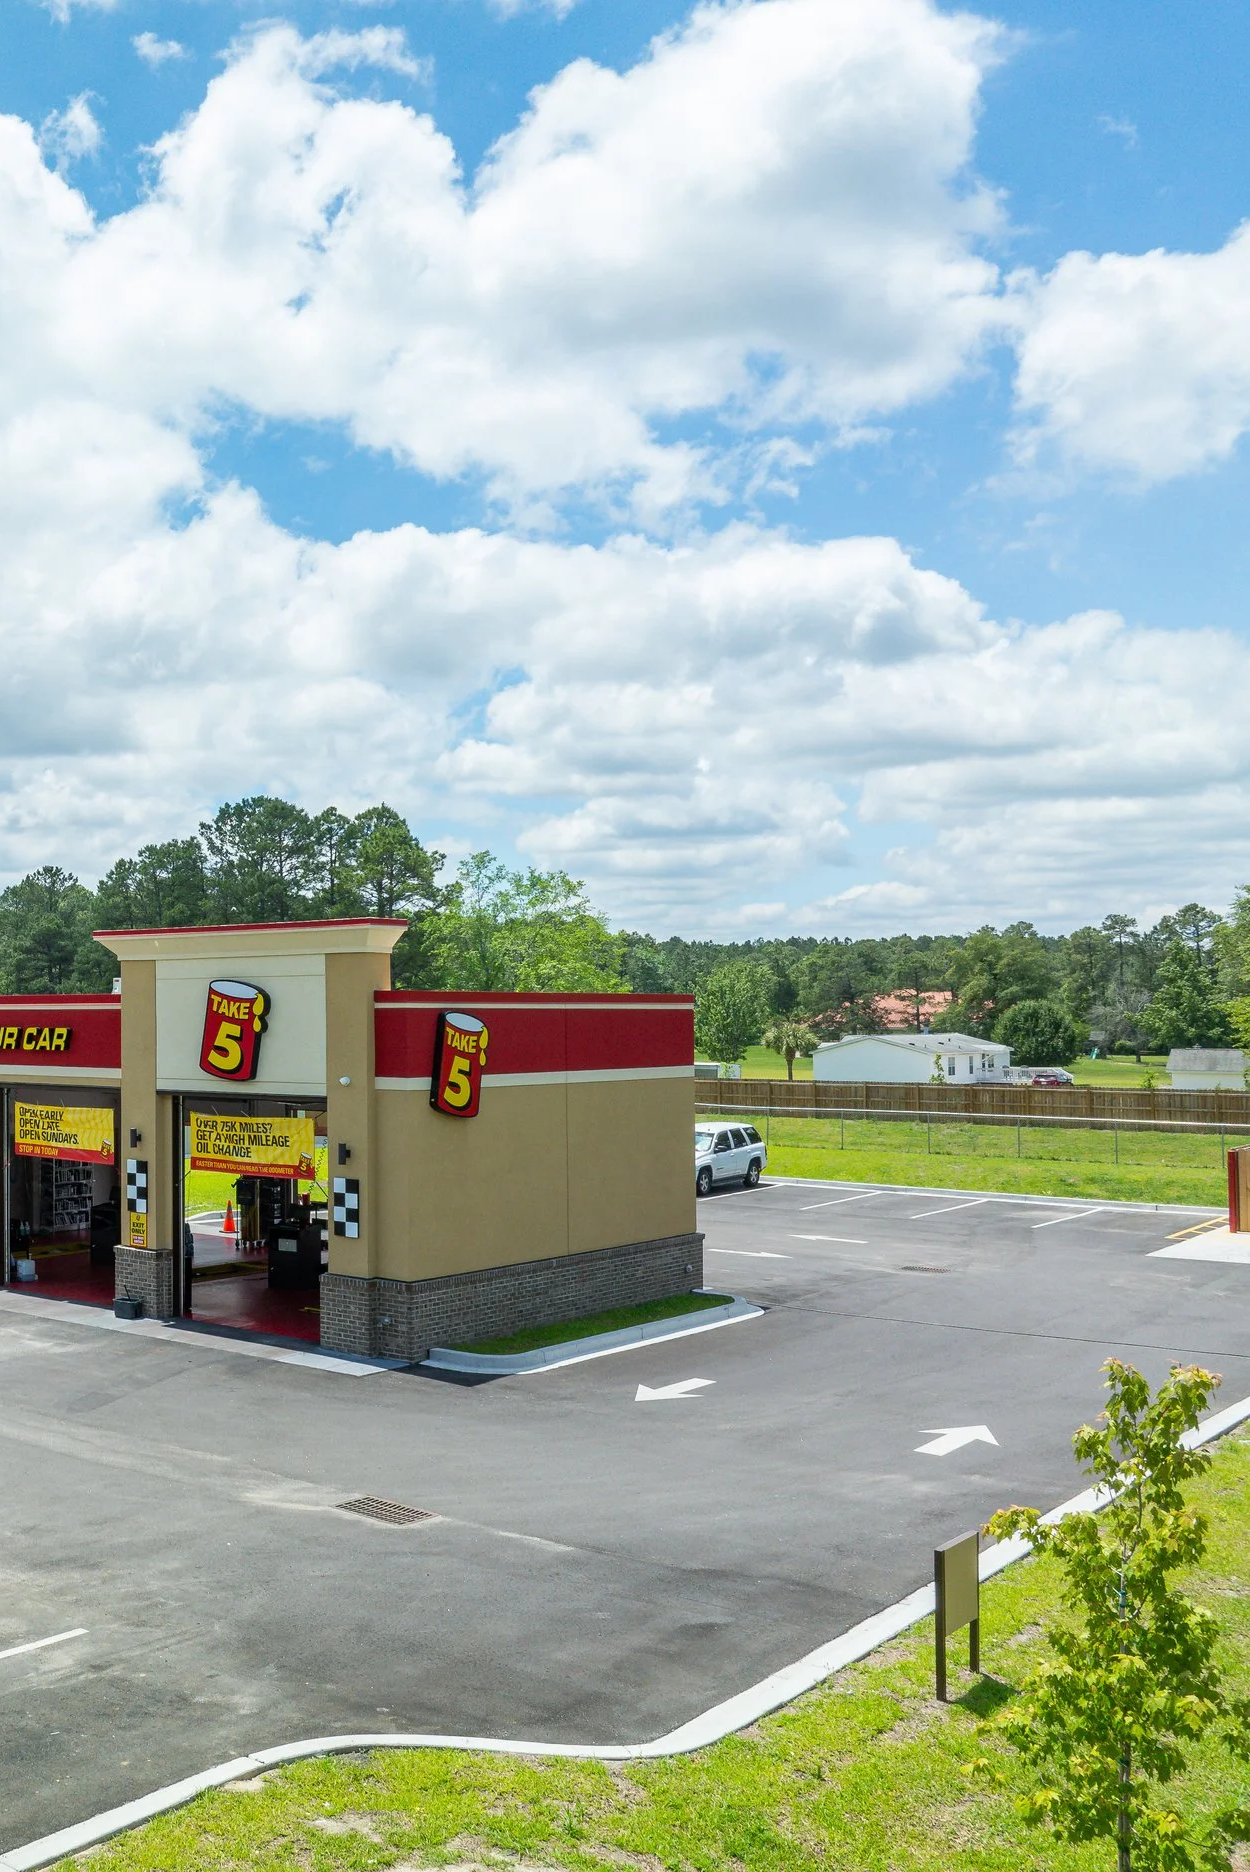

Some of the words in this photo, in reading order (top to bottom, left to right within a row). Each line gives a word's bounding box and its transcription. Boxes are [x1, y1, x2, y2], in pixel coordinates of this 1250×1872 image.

[211, 994, 250, 1020] TAKE
[22, 1027, 68, 1051] CAR
[208, 1021, 242, 1070] 5
[446, 1026, 478, 1054] TAKE
[444, 1055, 470, 1107] 5
[19, 1106, 38, 1118] OPEN
[19, 1118, 40, 1129] OPEN
[196, 1117, 217, 1132] OVER
[220, 1121, 237, 1132] 75K
[239, 1122, 272, 1134] MILES?
[20, 1129, 40, 1140] OPEN
[42, 1131, 79, 1144] SUNDAYS.
[196, 1129, 214, 1142] GET
[214, 1133, 221, 1142] A
[248, 1134, 290, 1148] MILEAGE
[19, 1145, 33, 1153] STOP
[41, 1147, 59, 1156] TODAY
[196, 1142, 210, 1154] OIL
[213, 1144, 252, 1158] CHANGE
